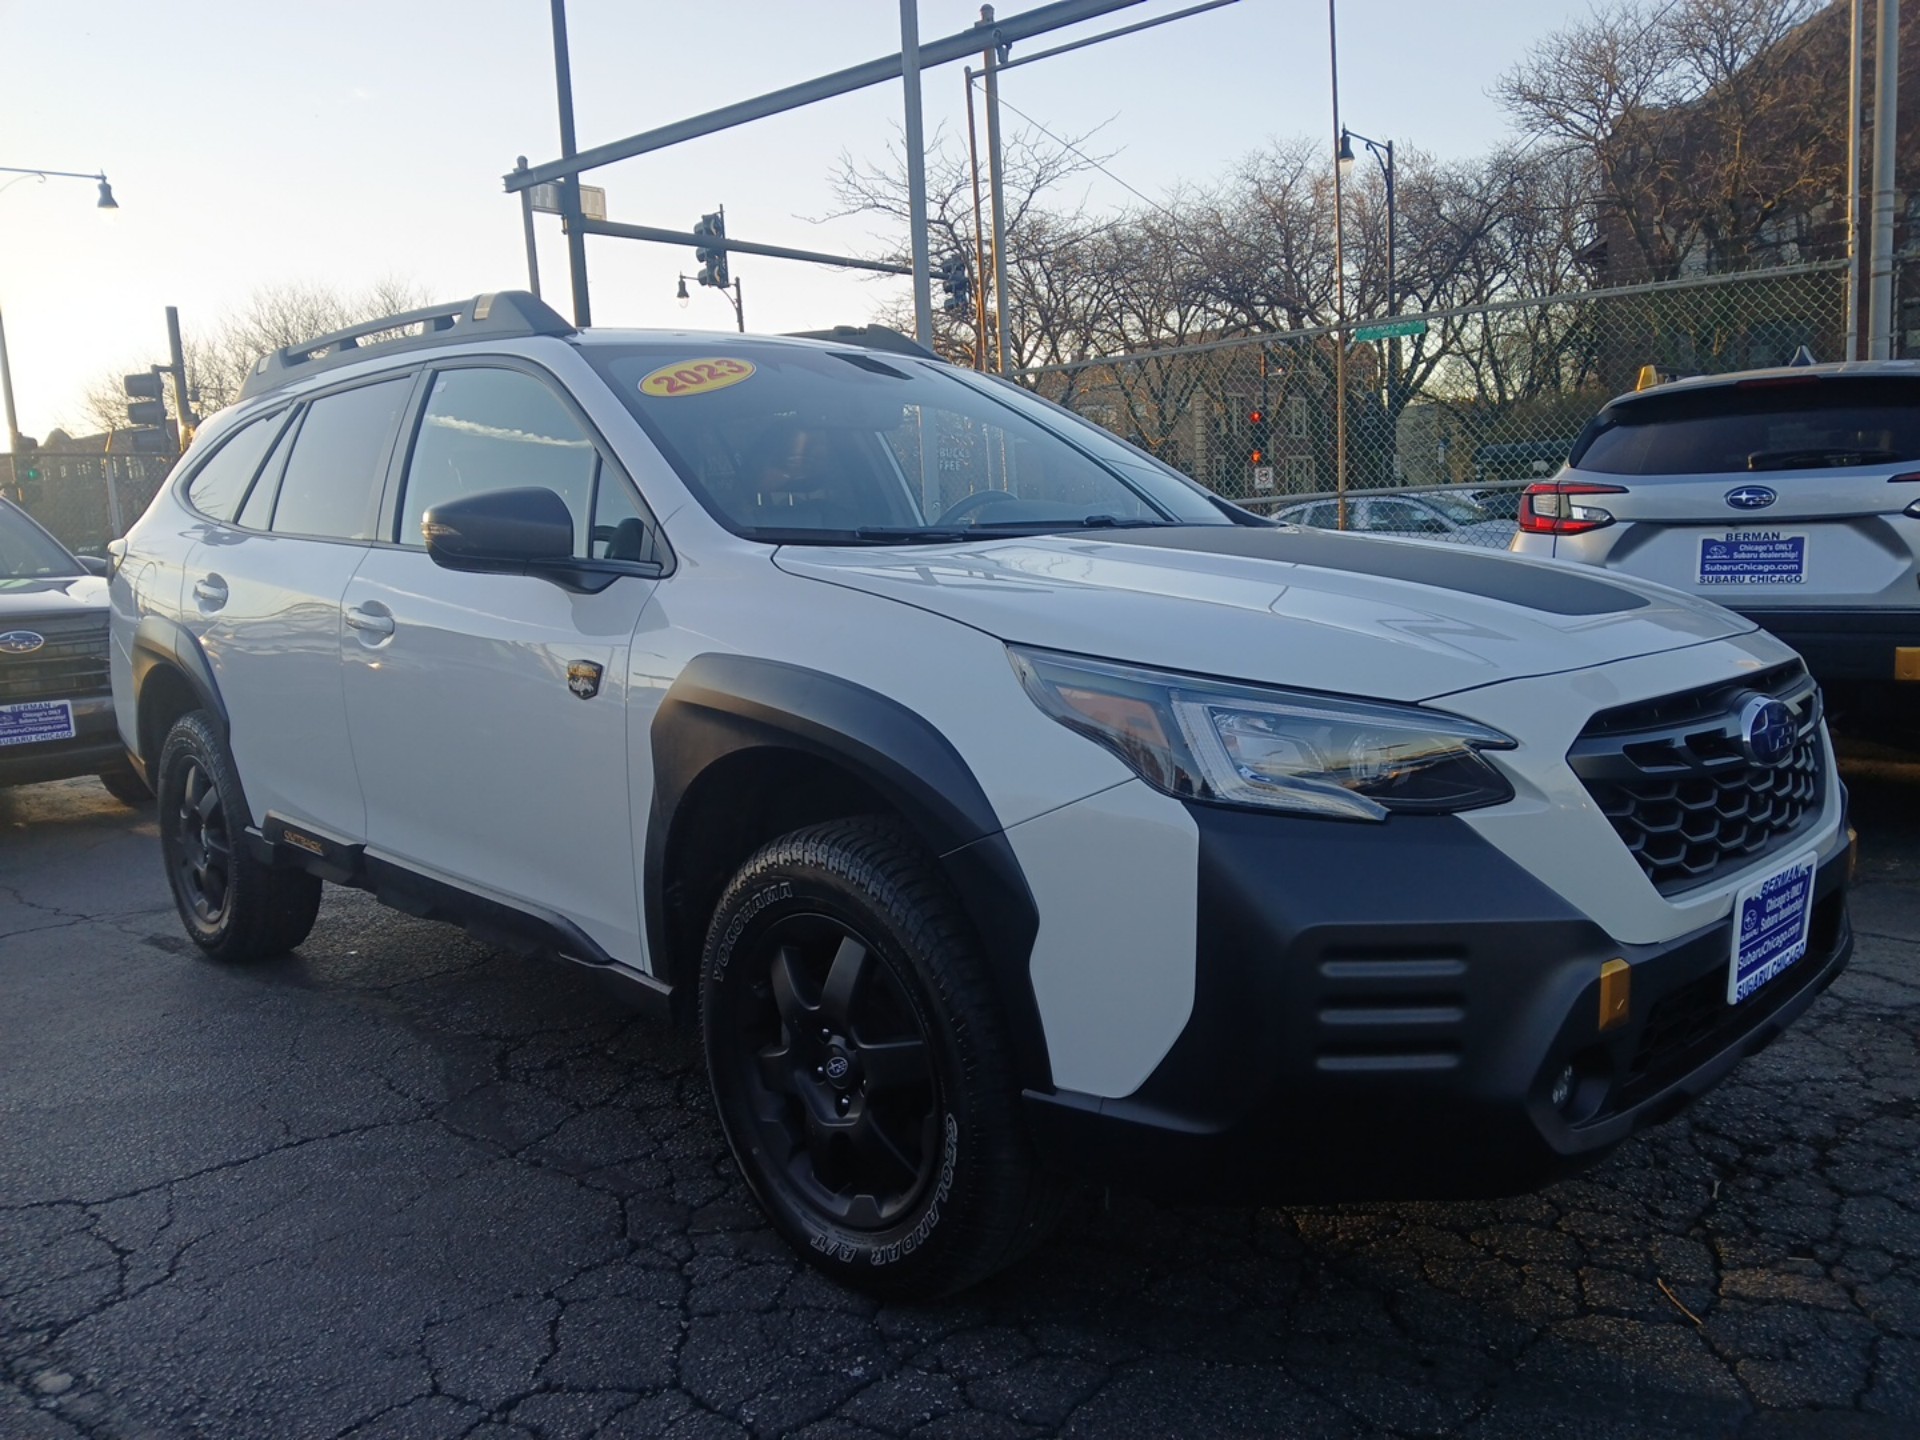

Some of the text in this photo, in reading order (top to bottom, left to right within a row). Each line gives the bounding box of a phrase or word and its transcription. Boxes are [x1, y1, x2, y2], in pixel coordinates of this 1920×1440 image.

[652, 359, 748, 394] 2023
[1725, 532, 1780, 541] BERMAN
[1759, 551, 1798, 560] dealership!
[1774, 543, 1794, 551] ONLY
[1704, 563, 1798, 572] SubaruChicago.com
[1699, 575, 1802, 583] SUBARU CHICAGO
[10, 702, 52, 712] BERMAN
[35, 731, 72, 740] CHICAGO
[1761, 863, 1802, 895] BERMAN
[1766, 880, 1804, 912] Chicago's ONLY
[713, 881, 793, 982] YOKOHAMA
[1761, 913, 1778, 932] Subaru
[1738, 921, 1801, 971] SubaruChicago.com
[1736, 940, 1805, 1001] SUBARU CHICAGO
[870, 1112, 958, 1266] GEOLANDAR
